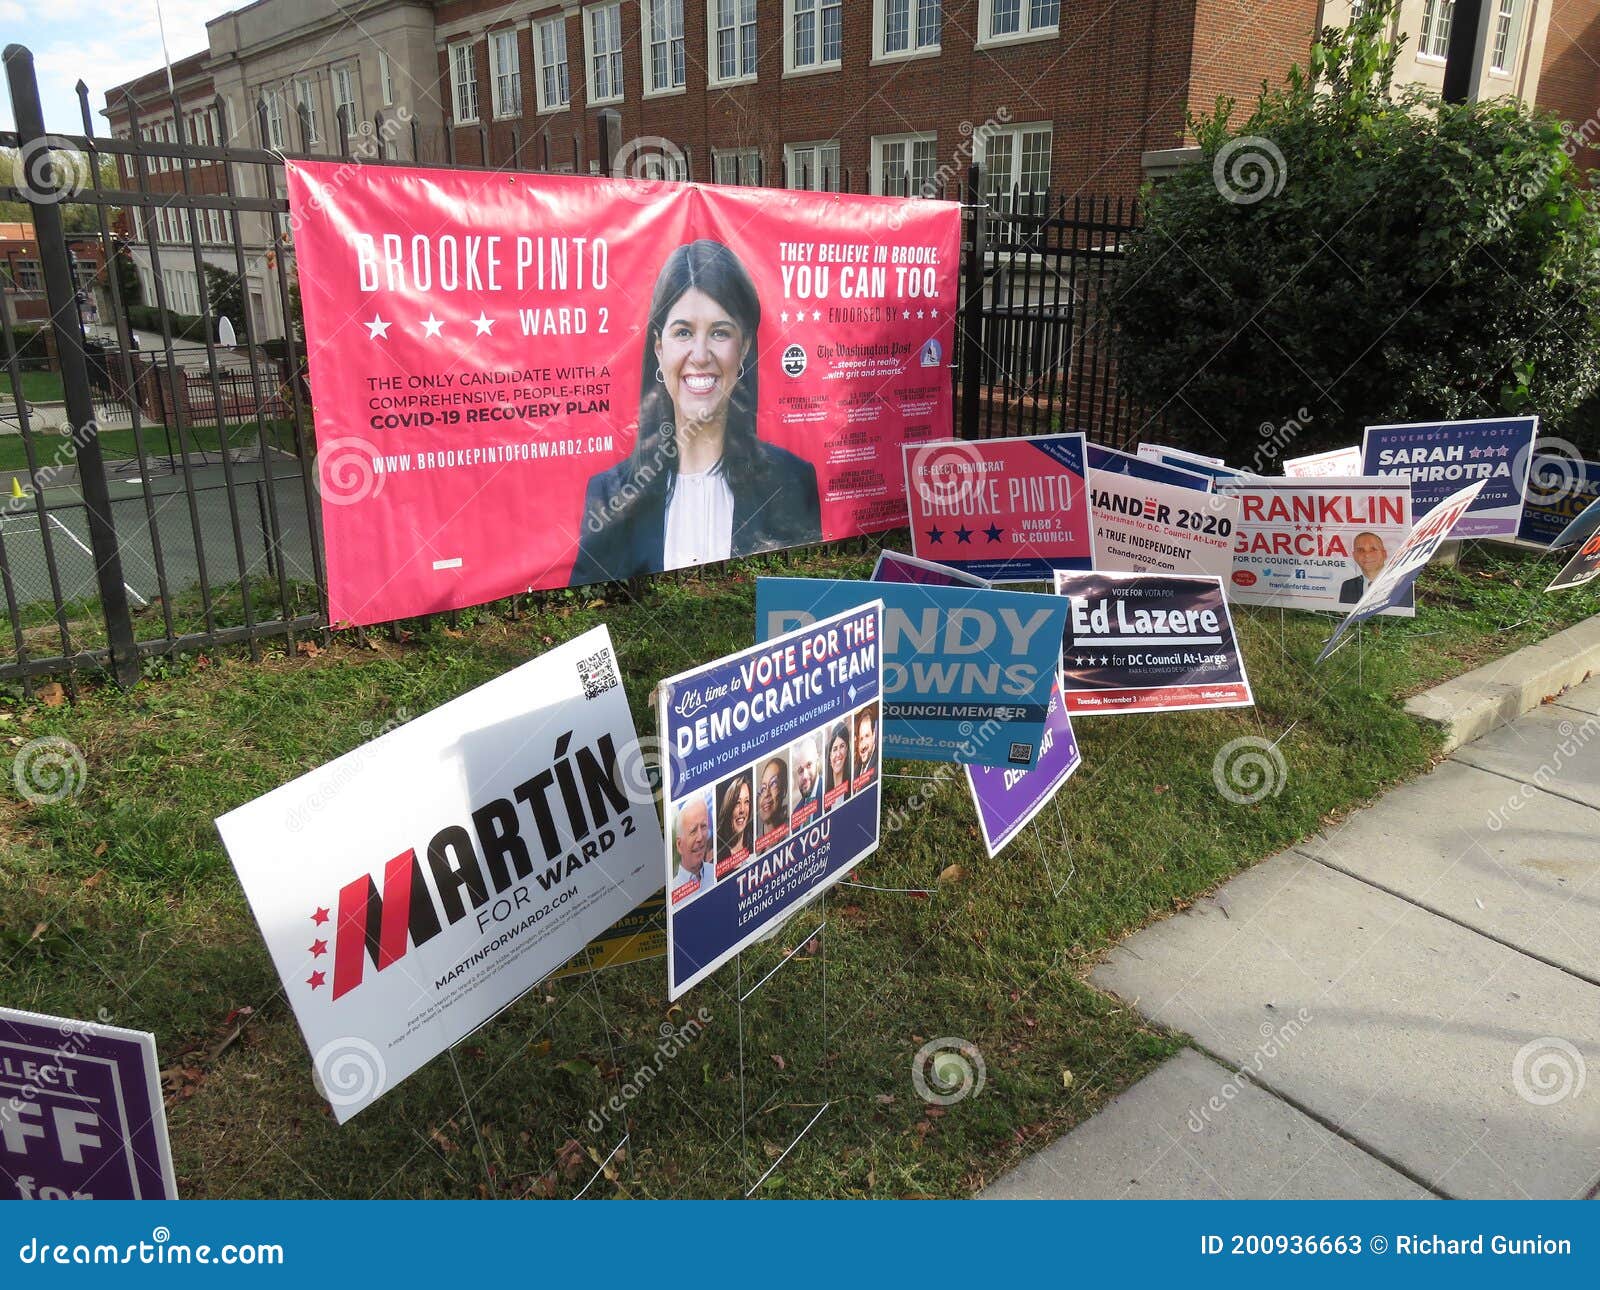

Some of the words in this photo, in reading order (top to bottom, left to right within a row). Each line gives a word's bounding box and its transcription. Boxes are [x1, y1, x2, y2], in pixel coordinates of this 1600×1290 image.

[357, 233, 502, 292] BROOKE
[517, 237, 609, 290] PINTO
[780, 242, 815, 262] THEY
[818, 243, 870, 263] BELIEVE
[873, 245, 887, 263] IN
[891, 246, 940, 265] BROOKE.
[781, 265, 829, 299] YOU
[840, 266, 886, 299] CAN
[896, 267, 940, 298] TOO.
[519, 308, 588, 336] WARD
[598, 307, 609, 333] 2
[828, 307, 881, 323] ENDORSED
[886, 307, 898, 322] BY
[817, 344, 834, 358] The
[835, 341, 891, 359] Washington
[891, 342, 912, 355] Post
[877, 358, 900, 367] reality
[367, 375, 402, 391] THE
[407, 374, 454, 389] ONLY
[459, 368, 552, 387] CANDIDATE
[555, 366, 595, 381] WITH
[599, 366, 611, 378] A
[845, 370, 860, 380] grit
[861, 369, 876, 378] and
[369, 389, 510, 410] COMPREHENSIVE,
[513, 383, 610, 401] PEOPLE-FIRST
[370, 411, 460, 430] COVID-19
[466, 403, 561, 424] RECOVERY
[565, 399, 611, 416] PLAN
[1381, 433, 1449, 443] NOVEMBER
[372, 436, 614, 474] WWW.BROOKEPINTOFORWARD2.COM
[918, 463, 954, 476] RE-ELECT
[957, 460, 1005, 474] DEMOCRAT
[1379, 446, 1464, 466] SARAH
[1378, 462, 1511, 484] MEHROTRA
[919, 479, 1001, 517] BROOKE
[1008, 474, 1073, 513] PINTO
[1242, 495, 1404, 525] RANKLIN
[1476, 492, 1508, 500] CATION
[1021, 519, 1051, 530] WARD
[1055, 519, 1062, 529] 2
[1090, 489, 1171, 525] HANDER
[1176, 509, 1232, 537] 2020
[1012, 532, 1027, 543] DC
[1029, 531, 1075, 543] COUNCIL
[1097, 527, 1104, 538] A
[1105, 529, 1126, 543] TRUE
[1129, 533, 1192, 560] INDEPENDENT
[1100, 512, 1135, 527] Jayaraman
[1136, 520, 1146, 529] for
[1163, 527, 1191, 541] Council
[1193, 534, 1228, 549] At-Large
[1107, 546, 1175, 571] Chander2020.com
[1233, 556, 1249, 564] FOR
[1265, 557, 1302, 566] COUNCIL
[1304, 560, 1346, 568] AT-LARGE
[1112, 588, 1129, 597] VOTE
[1130, 588, 1143, 597] FOR
[1071, 598, 1110, 634] Ed
[1117, 600, 1220, 634] Lazere
[675, 689, 707, 718] It's
[705, 680, 728, 702] time
[731, 677, 742, 692] to
[740, 644, 797, 692] VOTE
[802, 629, 840, 666] FOR
[843, 614, 876, 649] THE
[1112, 655, 1126, 666] for
[1128, 654, 1143, 666] DC
[1145, 653, 1181, 665] Council
[1184, 653, 1227, 668] At-Large
[882, 663, 1037, 696] OWNS
[676, 668, 824, 760] DEMOCRATIC
[828, 643, 876, 688] TEAM
[1077, 697, 1102, 705] Tuesday,
[1103, 696, 1132, 704] November
[679, 758, 715, 784] RETURN
[717, 747, 740, 765] YOUR
[741, 731, 769, 753] BALLOT
[771, 718, 798, 738] BEFORE
[799, 701, 835, 725] NOVEMBER
[835, 697, 840, 707] 3
[882, 735, 970, 749] rWard2.com
[332, 730, 630, 1002] MARTÍN
[736, 841, 799, 898] THANK
[800, 818, 831, 855] YOU
[475, 887, 531, 934] FOR
[536, 830, 616, 892] WARD
[621, 815, 637, 839] 2
[738, 885, 763, 912] WARD
[764, 883, 770, 895] 2
[771, 852, 816, 890] DEMOCRATS
[816, 842, 831, 862] FOR
[738, 897, 773, 927] LEADING
[775, 887, 785, 901] US
[786, 879, 797, 893] TO
[435, 885, 579, 990] MARTINFORWARD2.COM
[0, 1056, 78, 1087] LECT
